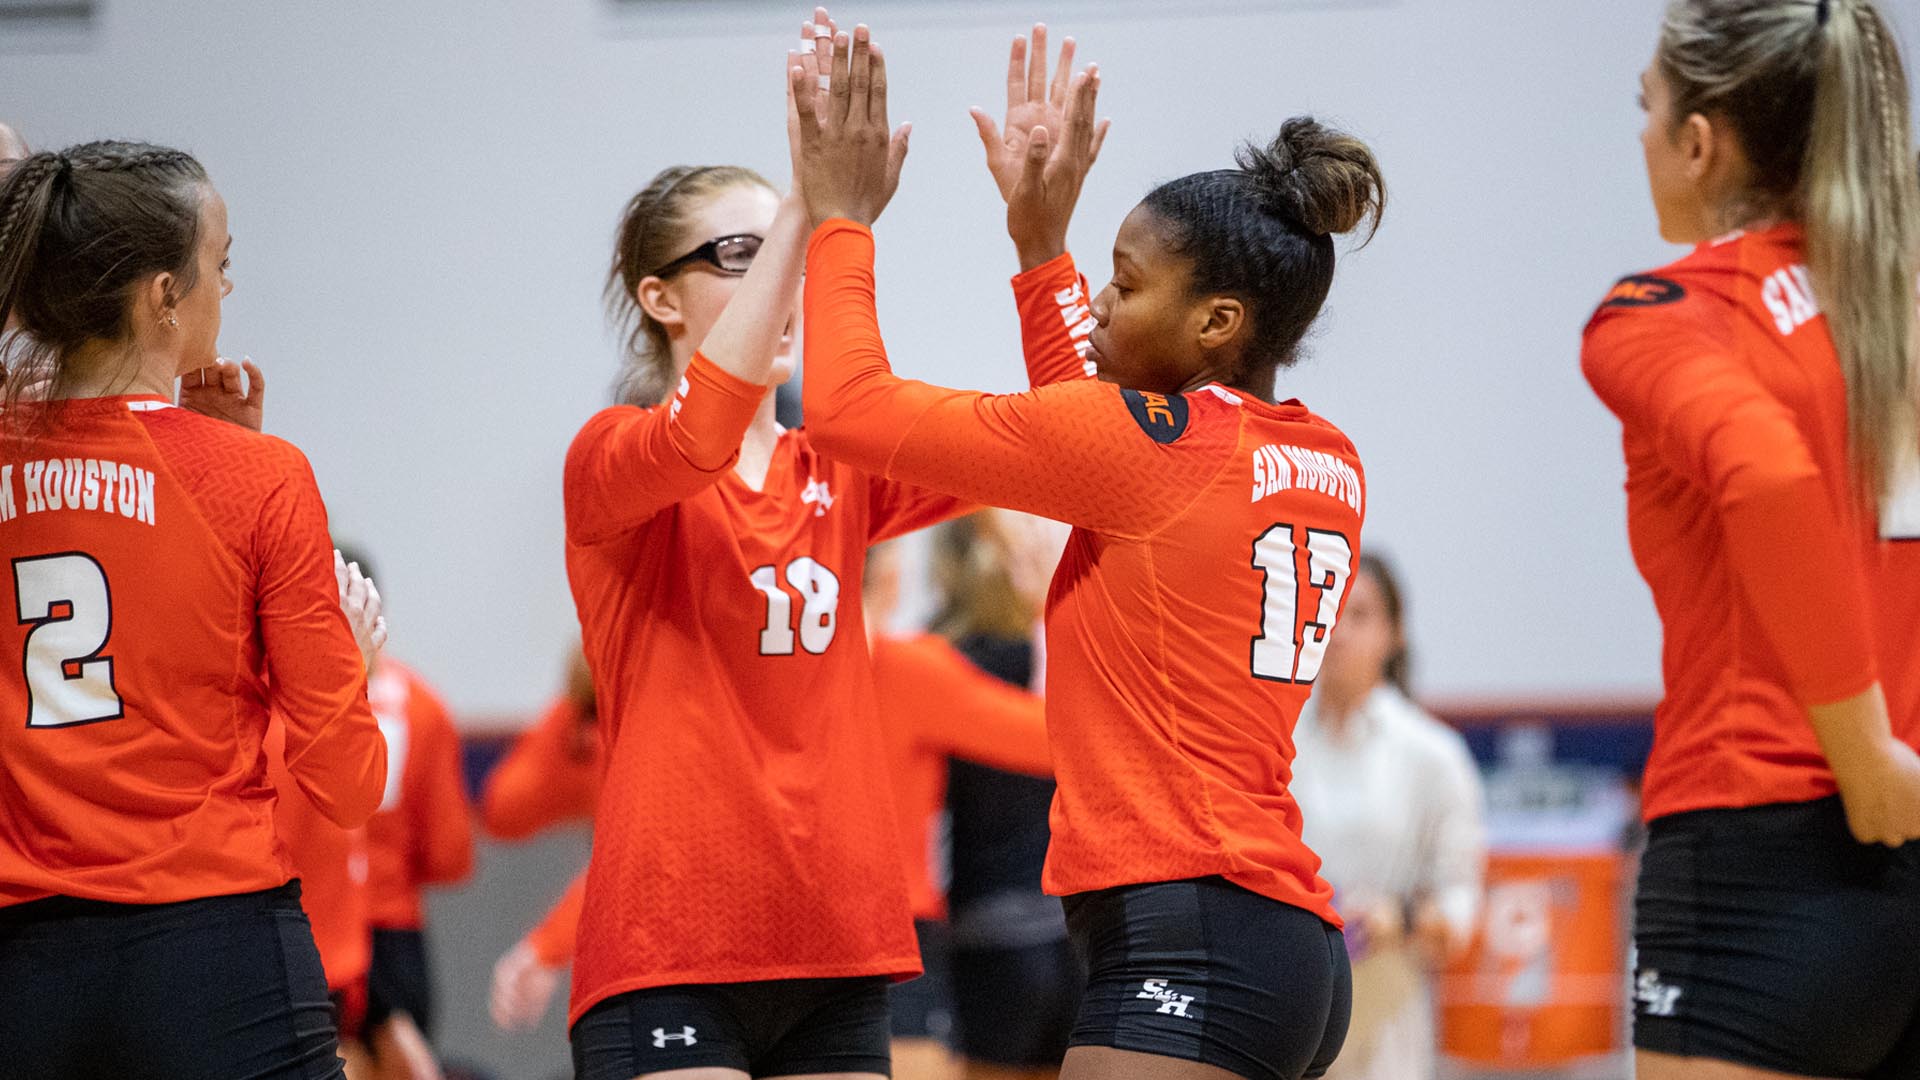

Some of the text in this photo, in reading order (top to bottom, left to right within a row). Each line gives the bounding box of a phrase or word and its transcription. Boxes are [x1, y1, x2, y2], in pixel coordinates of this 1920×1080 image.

[24, 458, 155, 526] HOUSTON
[1251, 444, 1362, 518] SAM HOUSTON
[11, 550, 125, 729] 2
[750, 556, 841, 655] 18
[1251, 521, 1352, 684] 13
